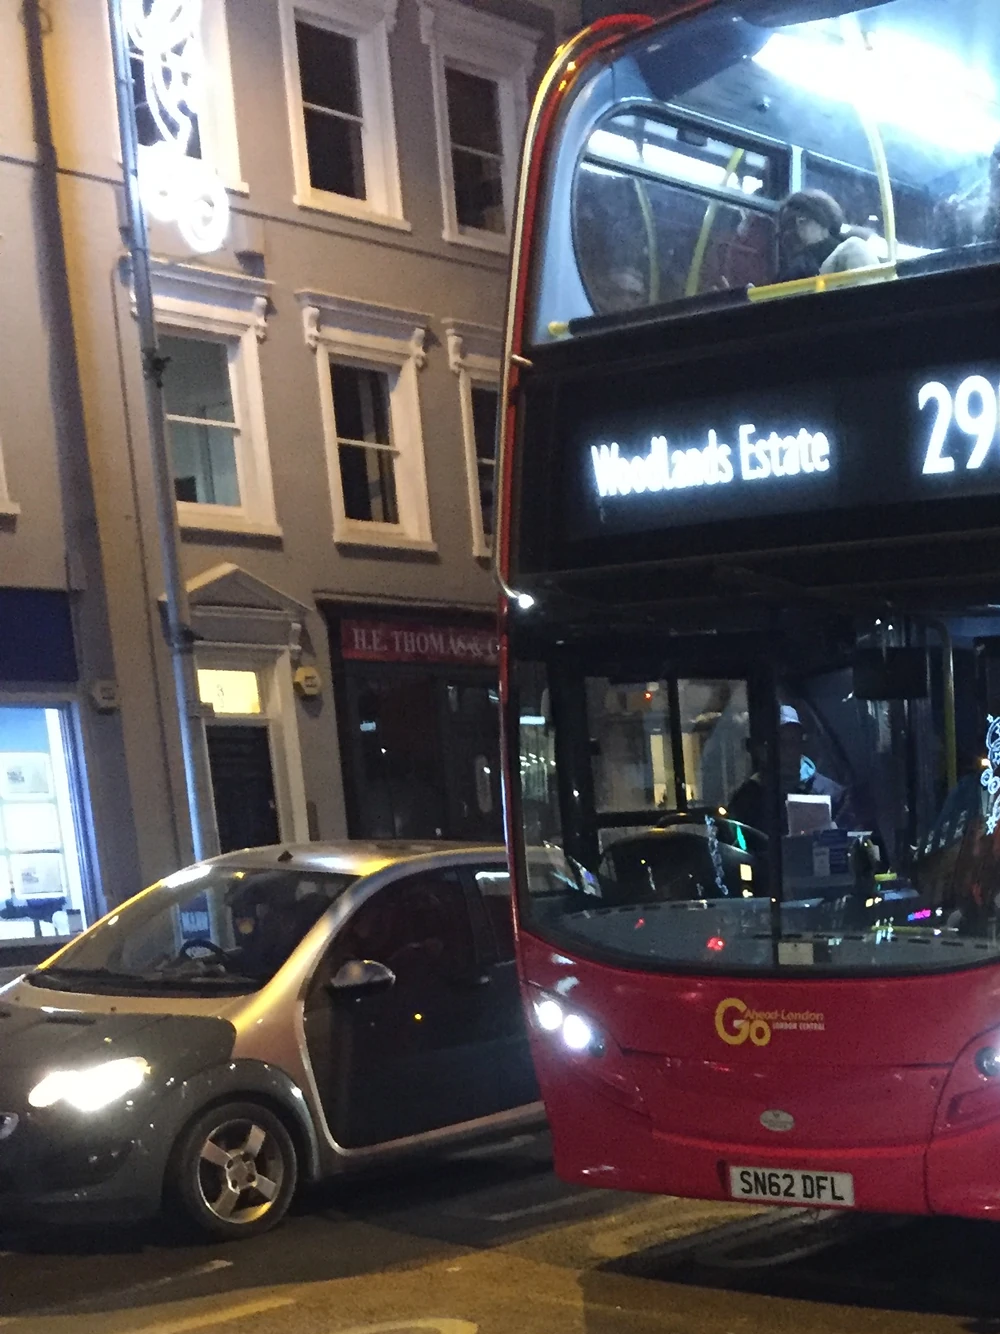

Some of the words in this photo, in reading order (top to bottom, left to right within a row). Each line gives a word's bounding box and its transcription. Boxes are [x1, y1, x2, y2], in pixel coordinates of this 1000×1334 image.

[591, 429, 734, 498] Woodlands
[738, 423, 831, 482] Estate
[391, 630, 467, 656] THOMAS
[715, 997, 771, 1046] Go
[740, 1170, 796, 1198] SN62
[801, 1174, 845, 1201] DFL
